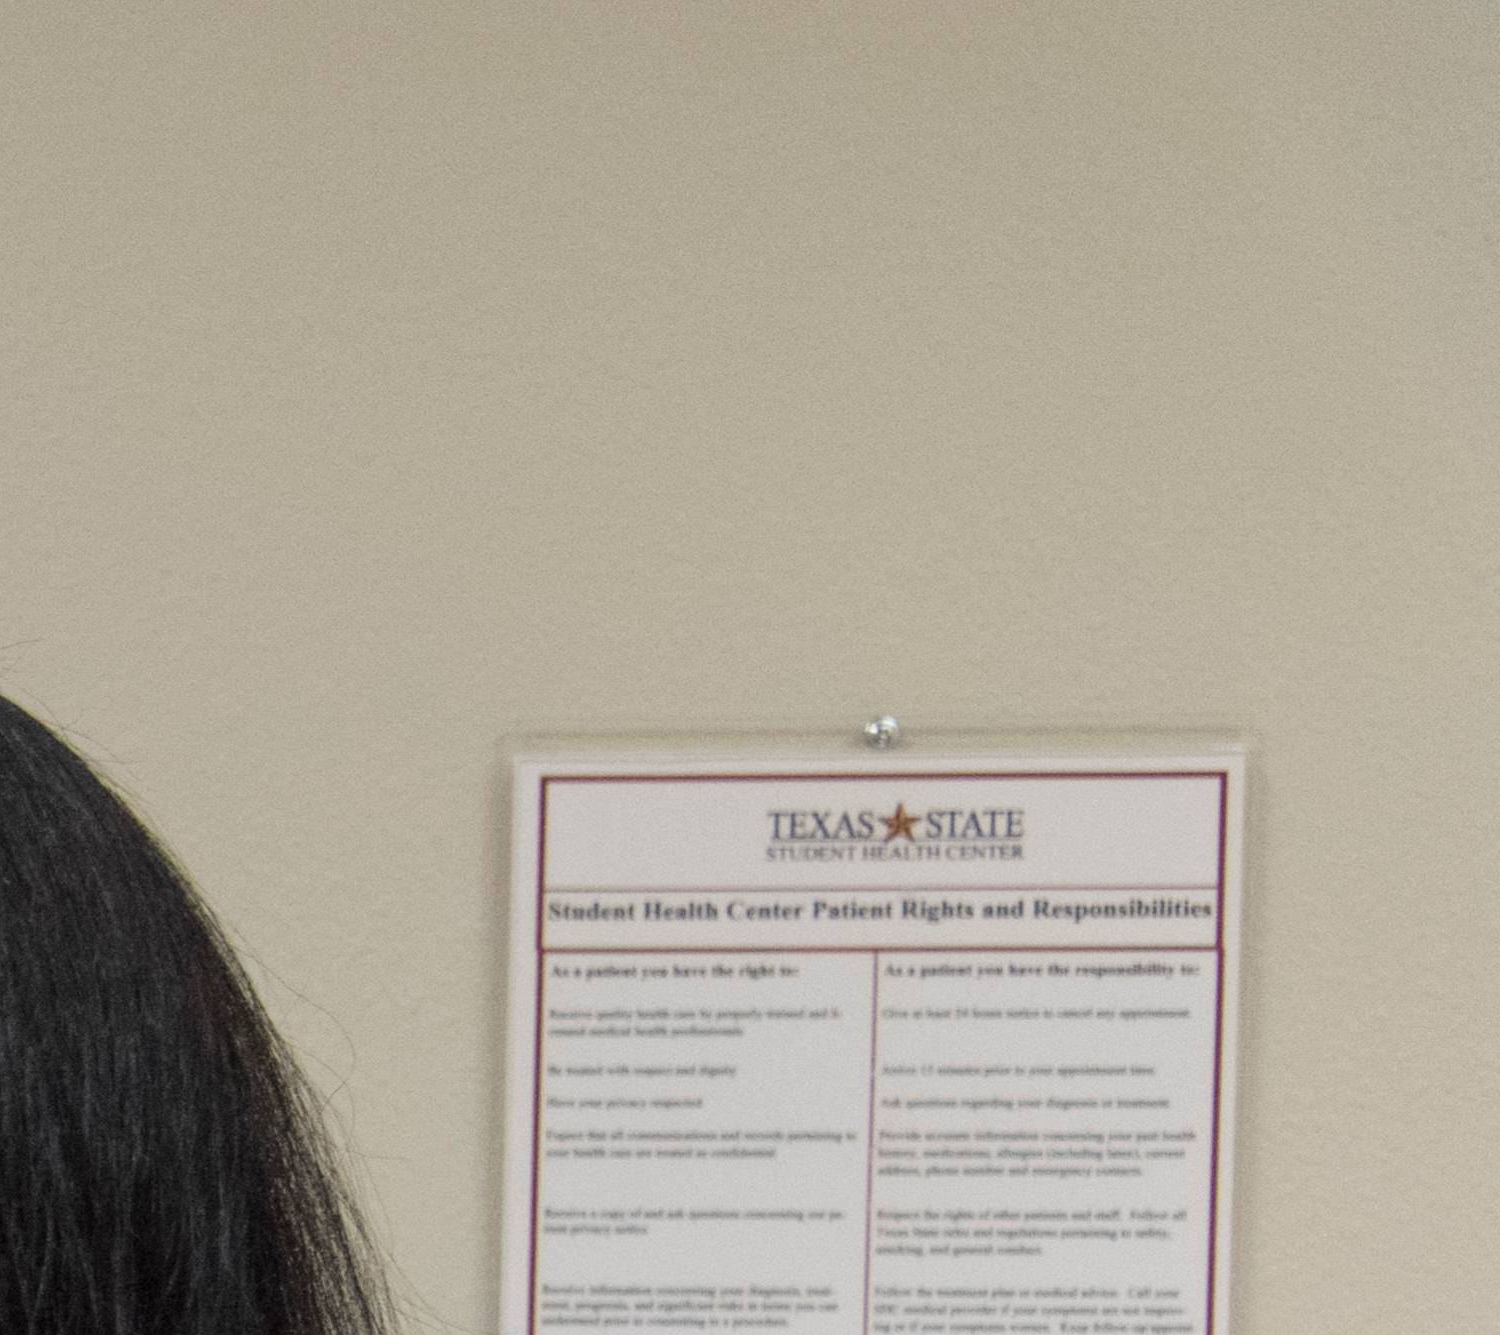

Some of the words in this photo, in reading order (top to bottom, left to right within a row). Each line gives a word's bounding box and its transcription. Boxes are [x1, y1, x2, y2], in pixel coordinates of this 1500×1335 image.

[767, 810, 875, 841] TEXAS
[925, 810, 1025, 840] STATE
[766, 846, 855, 862] STUDENT
[862, 845, 942, 861] HEALTH
[947, 845, 1025, 861] CENTER
[548, 902, 636, 922] Student
[643, 902, 719, 922] Health
[726, 902, 803, 922] Center
[812, 902, 892, 921] Patient
[902, 901, 974, 926] Rights
[983, 901, 1025, 920] and
[1033, 900, 1213, 925] Responsibilities
